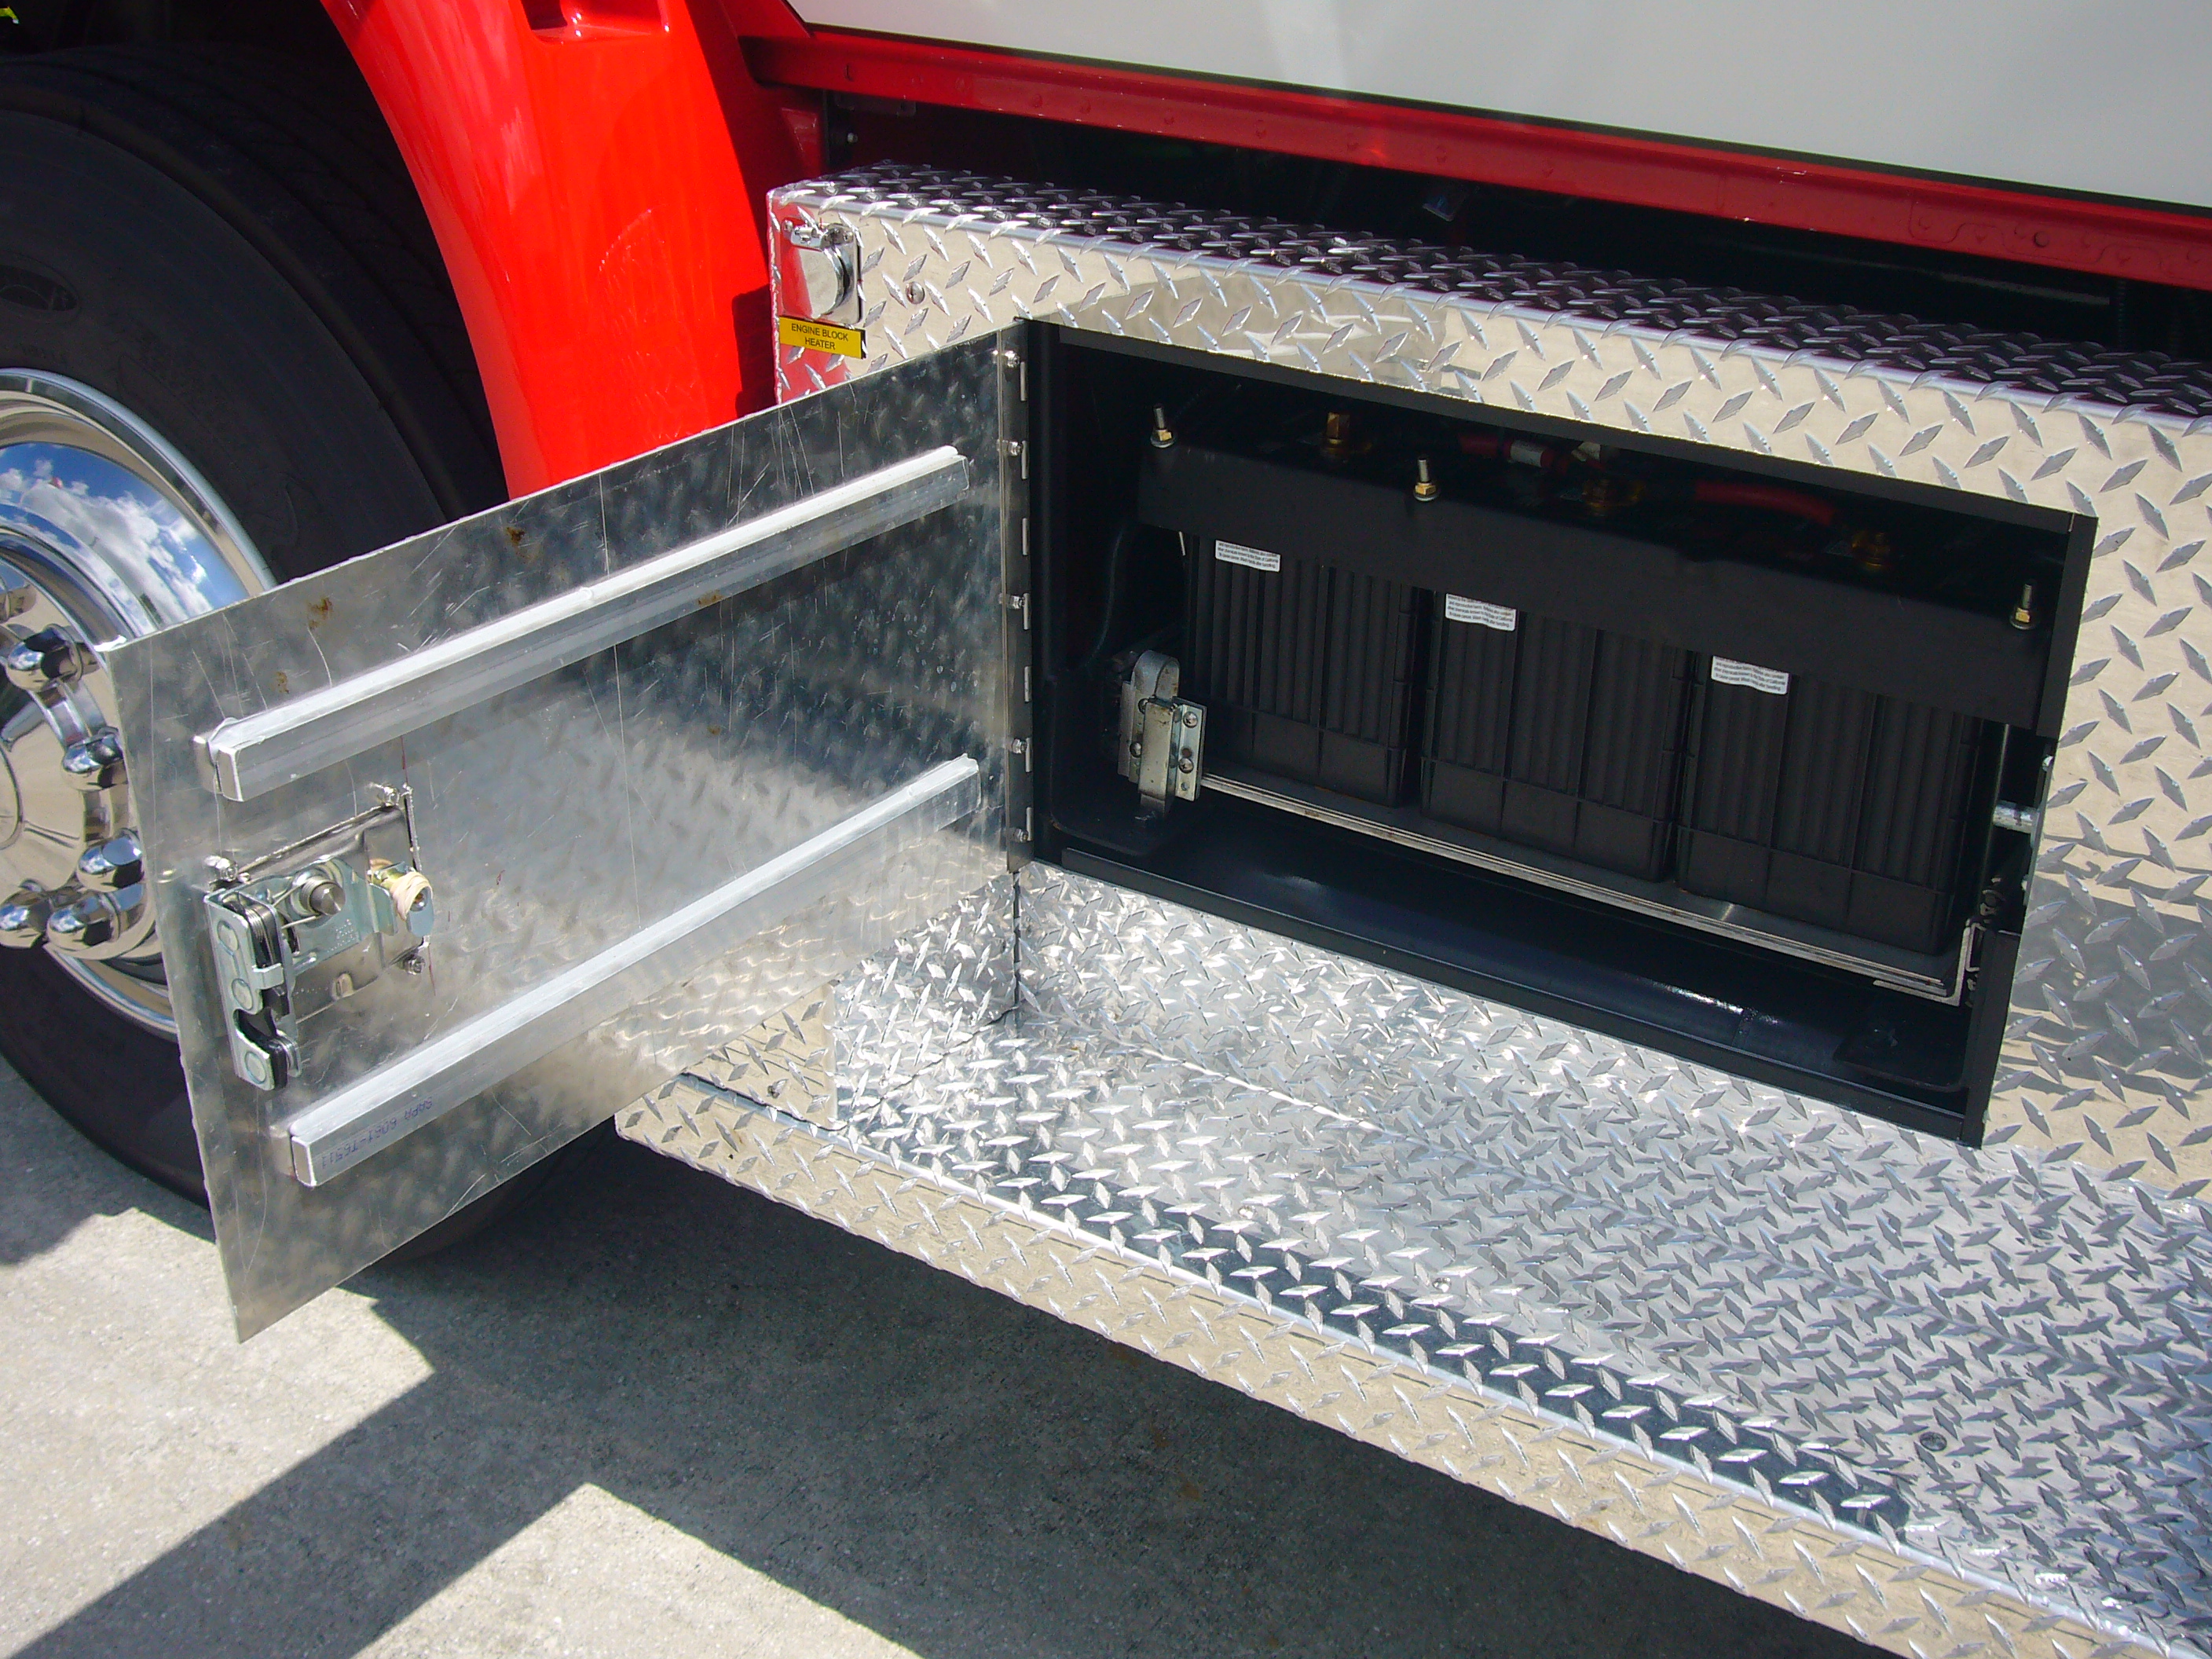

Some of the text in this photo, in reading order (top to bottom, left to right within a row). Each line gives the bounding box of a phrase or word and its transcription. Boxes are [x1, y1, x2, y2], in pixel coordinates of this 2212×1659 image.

[791, 323, 849, 342] ENGINE BLOCK
[804, 337, 836, 350] HEATER
